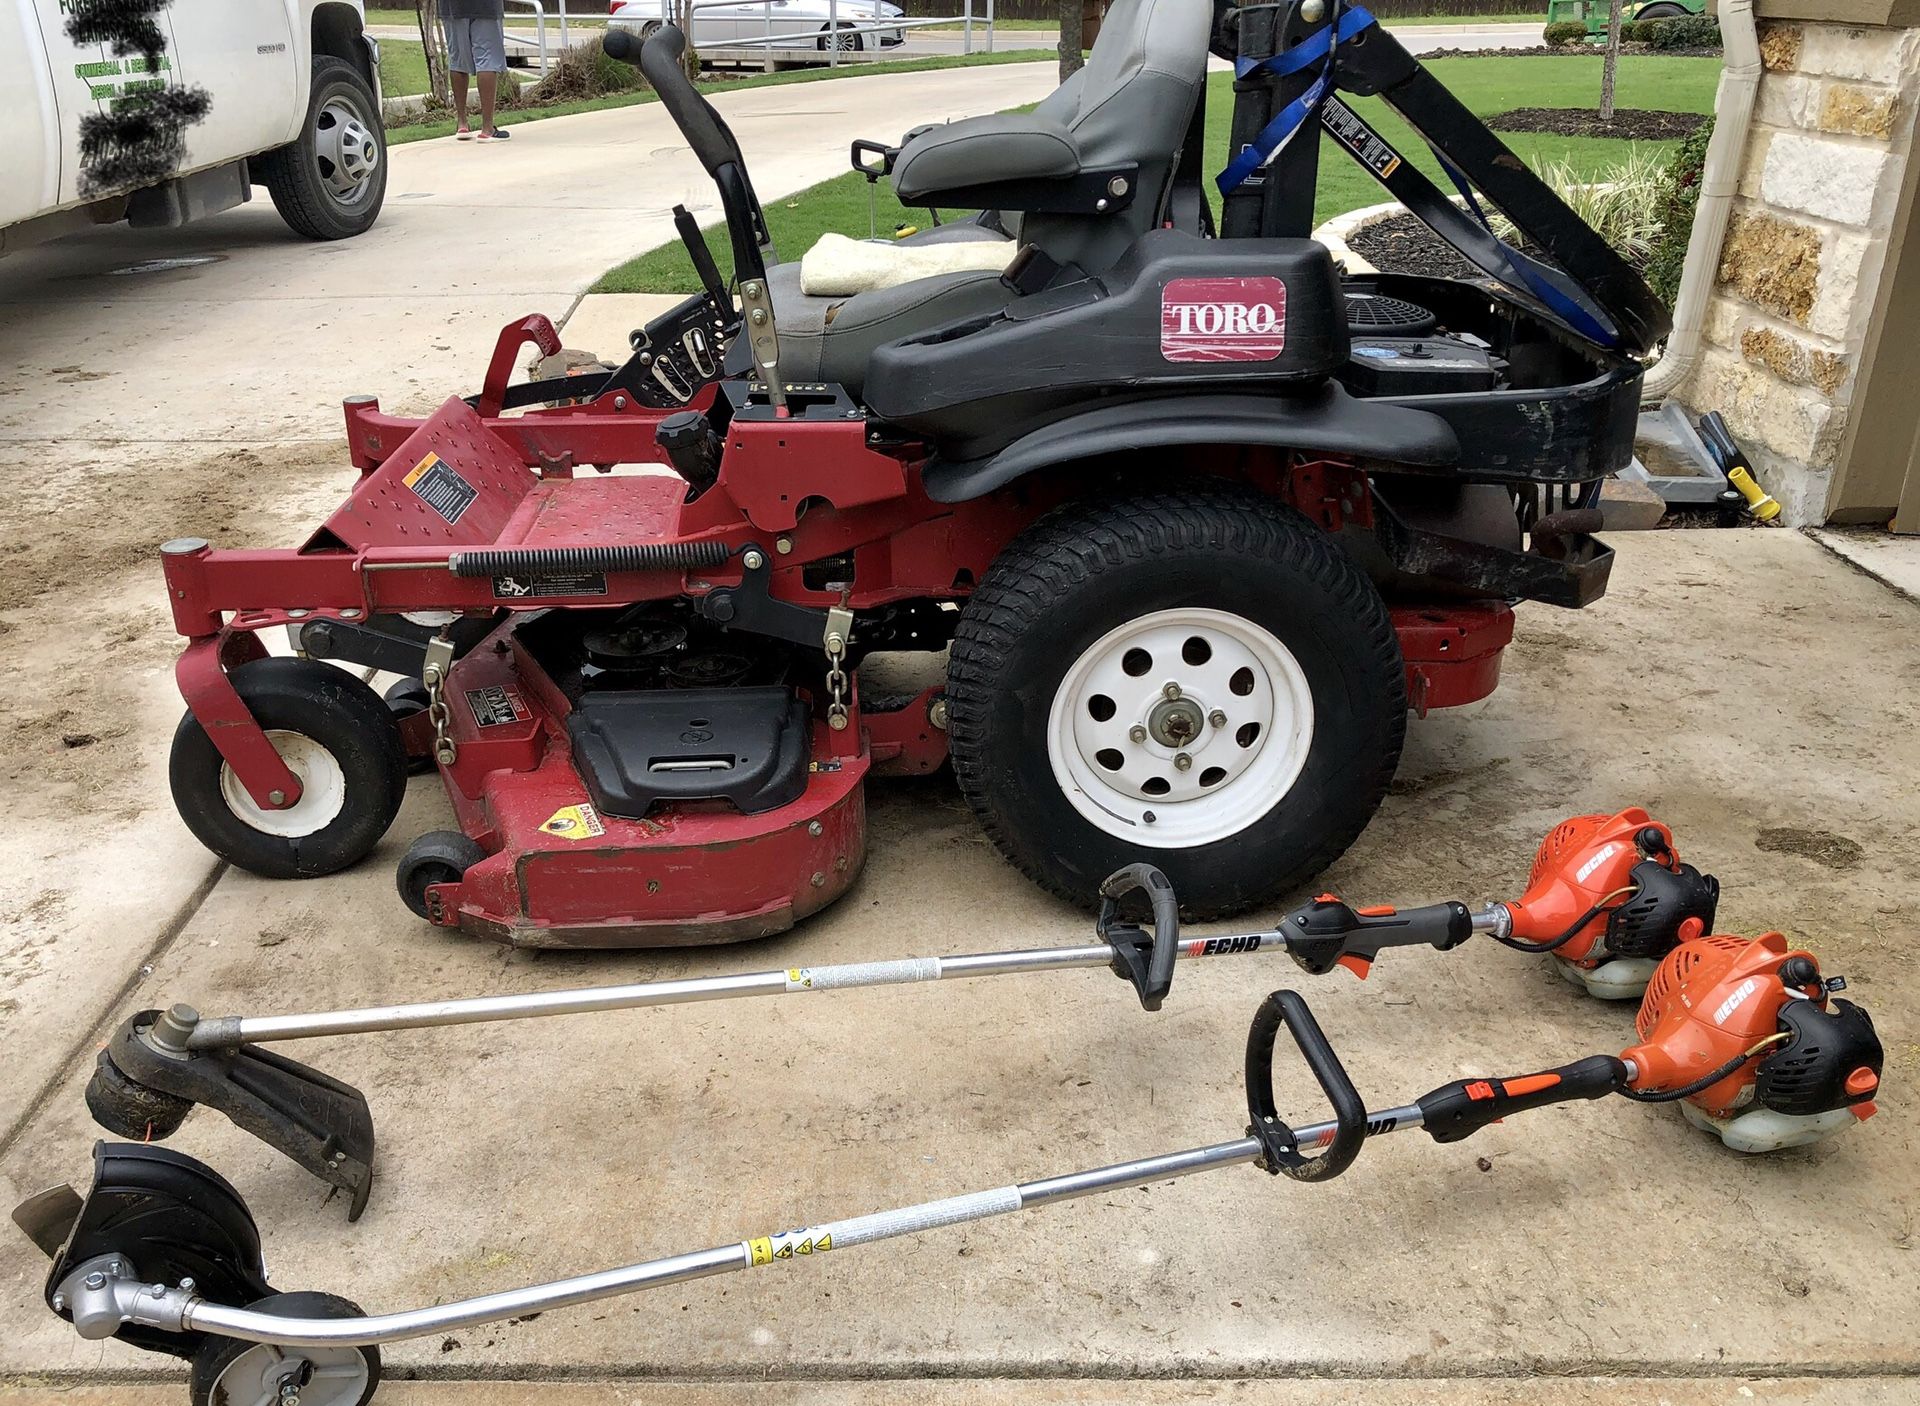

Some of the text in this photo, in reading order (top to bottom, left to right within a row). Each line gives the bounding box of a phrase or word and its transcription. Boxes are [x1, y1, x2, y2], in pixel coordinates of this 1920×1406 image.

[75, 60, 122, 79] COMMERCIAL
[1172, 303, 1276, 334] TORO
[579, 805, 601, 834] DANGER
[1582, 844, 1616, 876] ECHO
[1202, 936, 1261, 956] ECHO
[1721, 979, 1757, 1020] ECHO
[1366, 1117, 1397, 1138] HO
